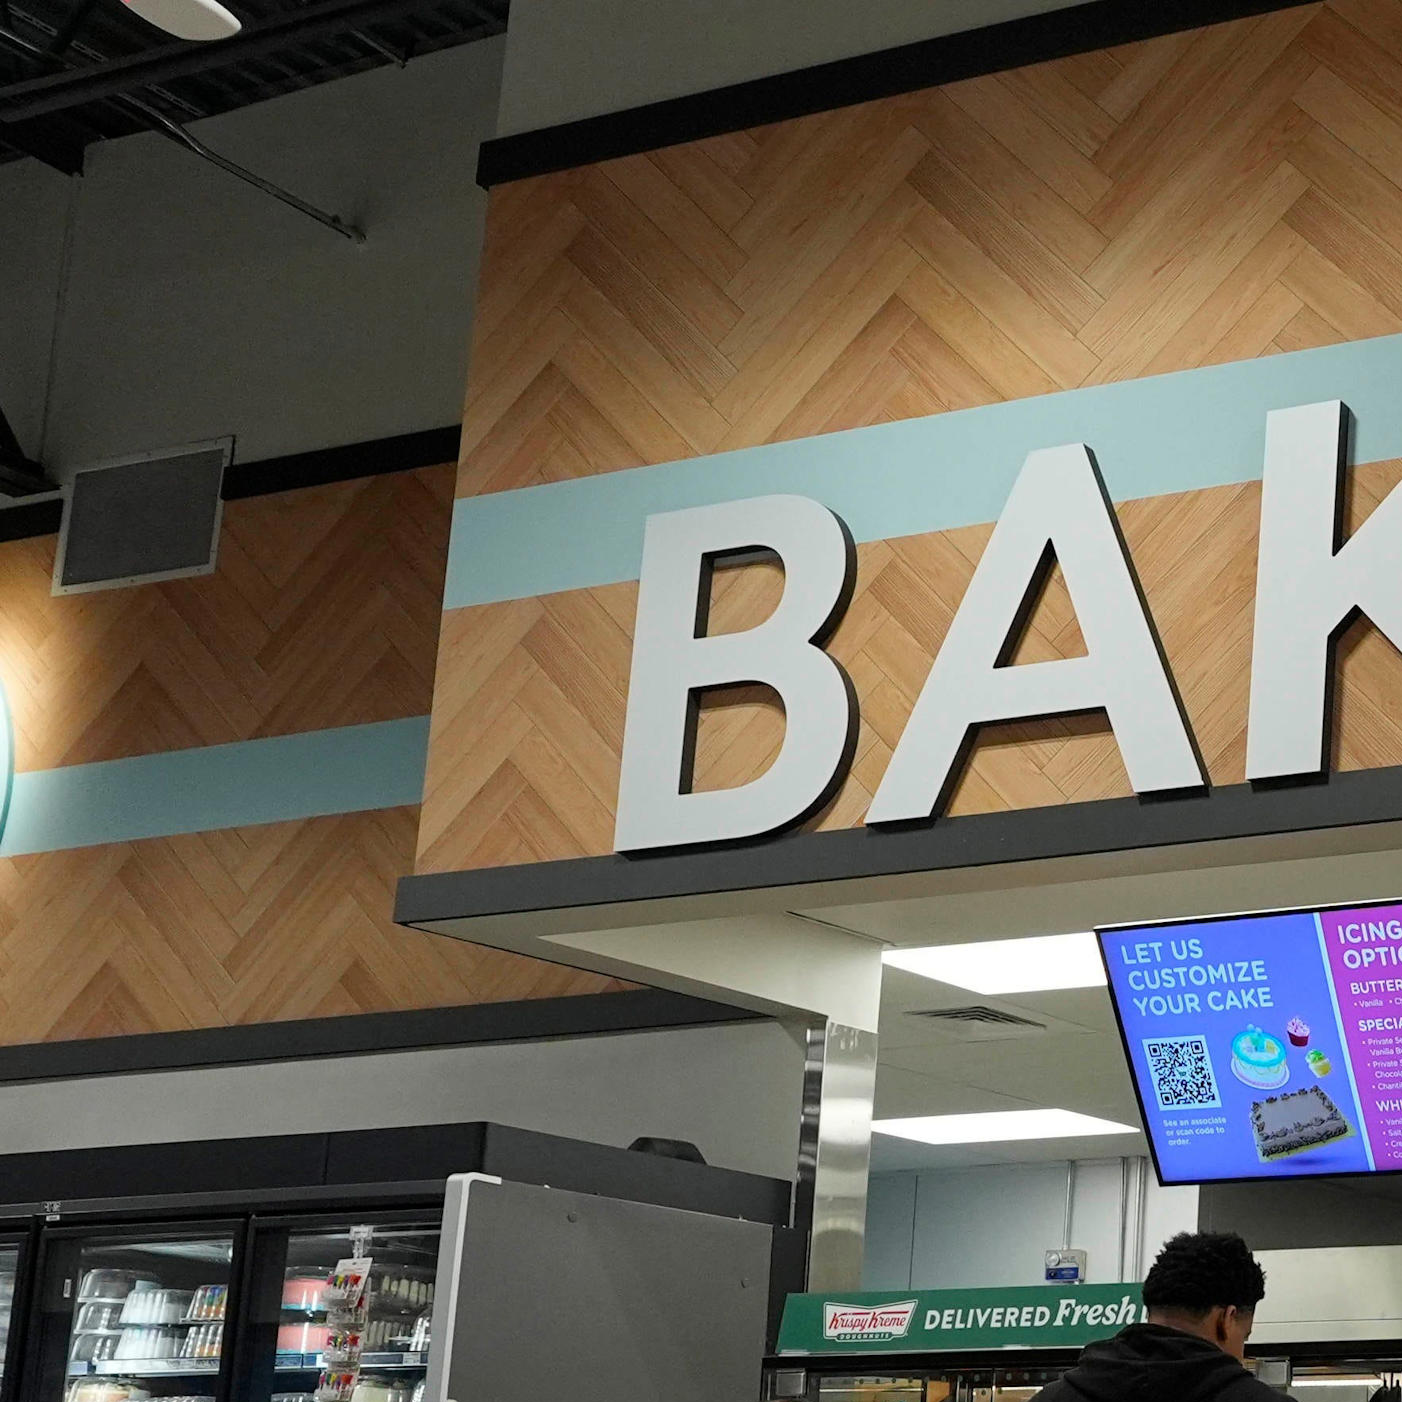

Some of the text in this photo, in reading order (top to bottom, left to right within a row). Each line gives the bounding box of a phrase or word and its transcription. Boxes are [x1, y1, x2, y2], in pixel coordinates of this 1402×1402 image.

[1121, 938, 1204, 965] LET US
[1127, 959, 1268, 992] CUSTOMIZE
[1132, 986, 1274, 1017] YOUR CAKE
[1359, 999, 1384, 1009] Vanilla
[1367, 1037, 1394, 1046] Private
[1370, 1047, 1394, 1057] Vanilla
[1372, 1060, 1398, 1069] Private
[828, 1310, 907, 1332] Krispy Kreme
[924, 1305, 1051, 1331] DELIVERED
[1052, 1295, 1136, 1328] Fresh
